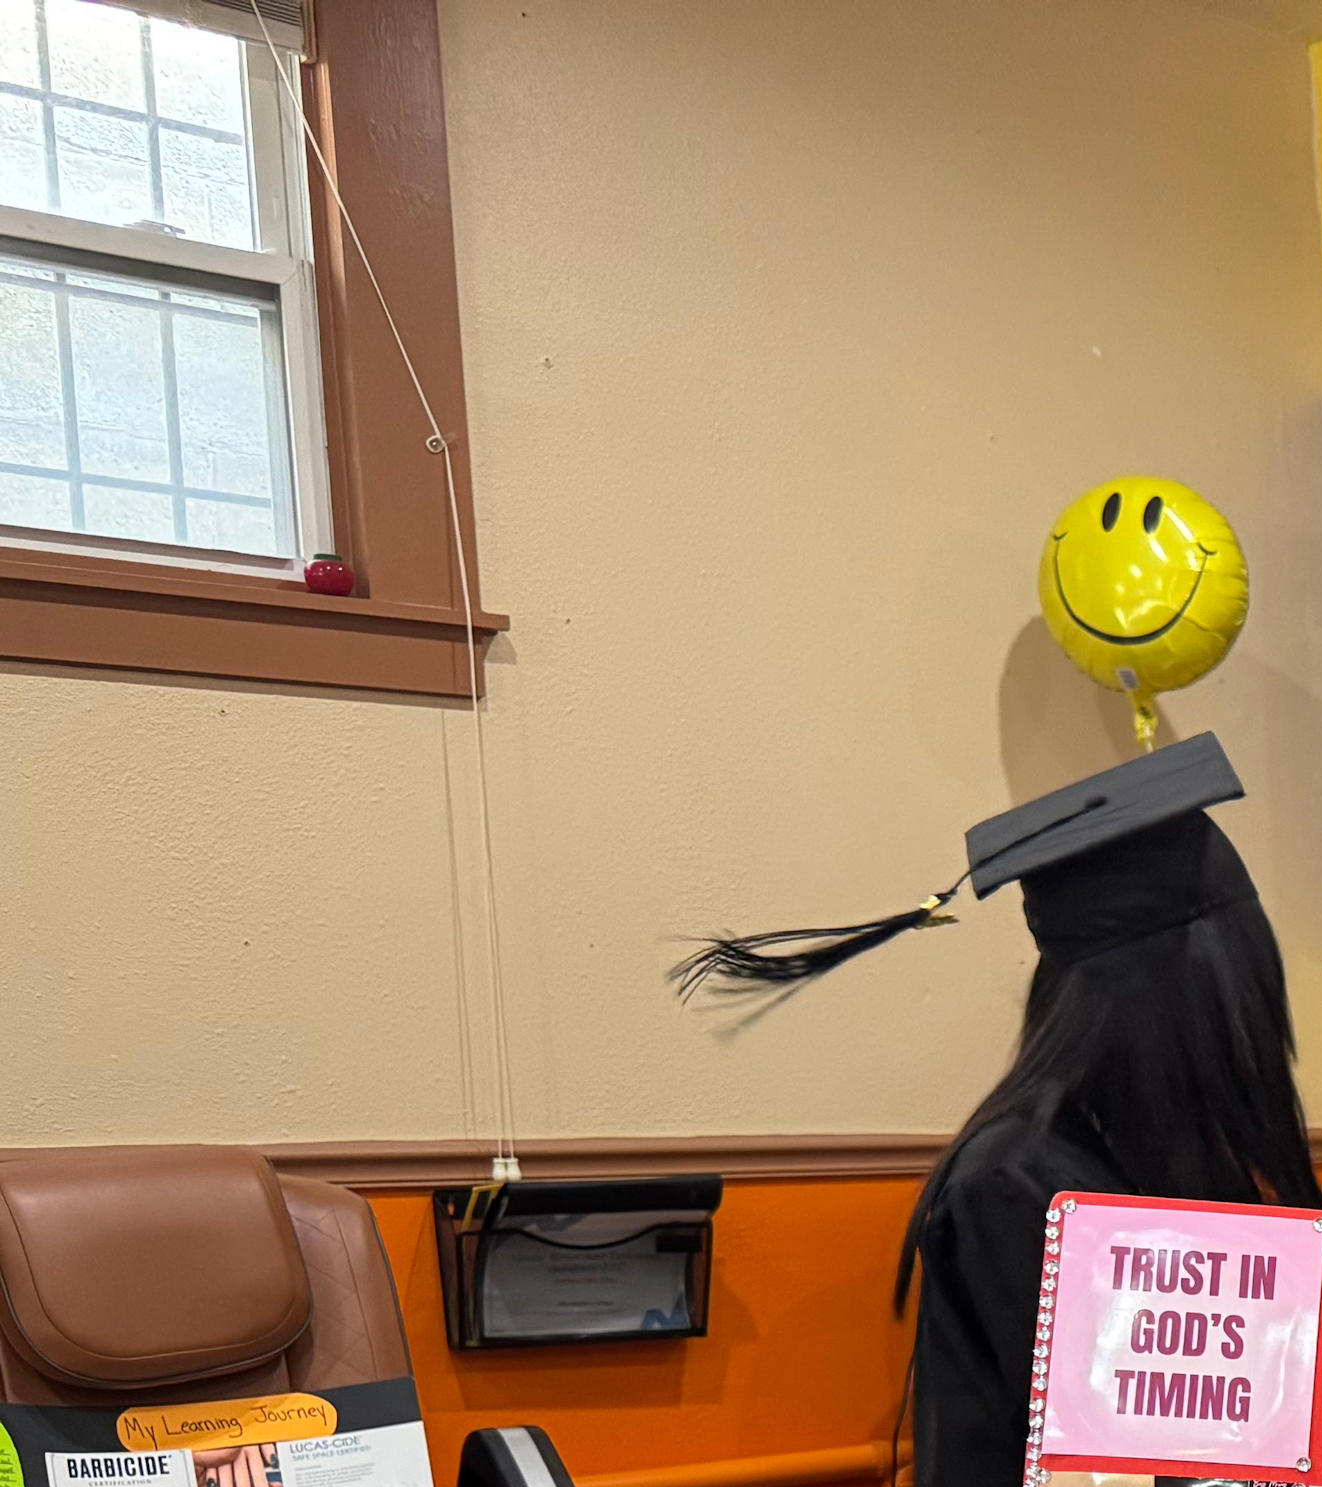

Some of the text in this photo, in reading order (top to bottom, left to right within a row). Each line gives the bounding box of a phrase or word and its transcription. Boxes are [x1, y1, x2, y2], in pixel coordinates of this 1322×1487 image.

[1109, 1244, 1278, 1301] TRUST IN
[1113, 1368, 1253, 1424] TIMING
[124, 1404, 328, 1450] My Learning Journey
[289, 1435, 362, 1454] LUCAS-CIDE
[67, 1455, 171, 1479] BARBICIDE
